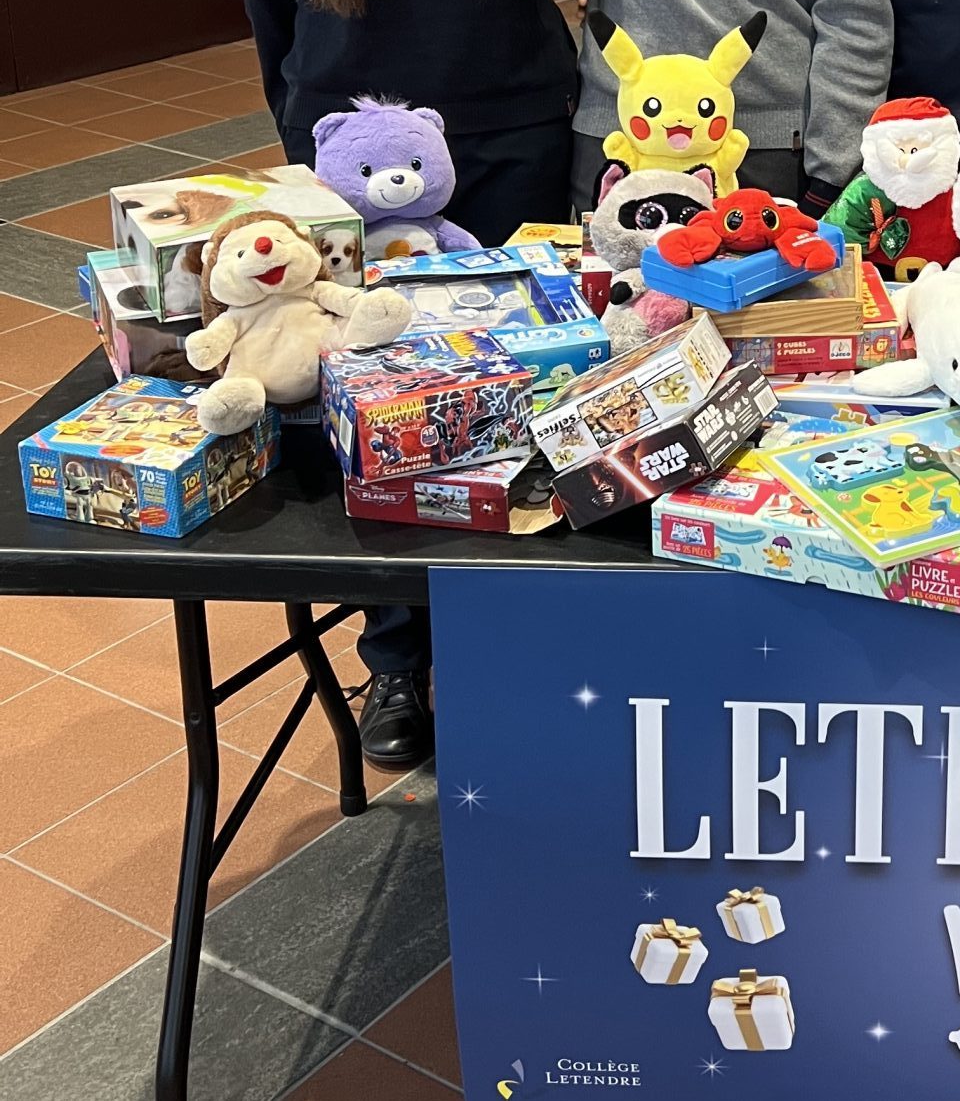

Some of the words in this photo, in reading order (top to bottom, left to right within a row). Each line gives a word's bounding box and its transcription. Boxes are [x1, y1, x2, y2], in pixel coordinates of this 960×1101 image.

[784, 348, 816, 356] PUZZLES
[537, 414, 576, 438] Selfies
[694, 404, 720, 434] STAR
[697, 412, 724, 444] WARS
[401, 452, 431, 464] Puzzle
[640, 442, 687, 472] WARS
[29, 463, 57, 479] TOY
[384, 462, 432, 476] Casse-tête
[640, 452, 690, 481] STAR
[140, 469, 155, 482] 70
[182, 470, 202, 492] TOY
[362, 492, 396, 502] PLANES
[912, 564, 948, 583] LIVRE
[911, 590, 923, 598] LES
[924, 592, 960, 606] COULEURS
[557, 1058, 640, 1073] COLLÈGE
[546, 1072, 642, 1086] LETENDRE
